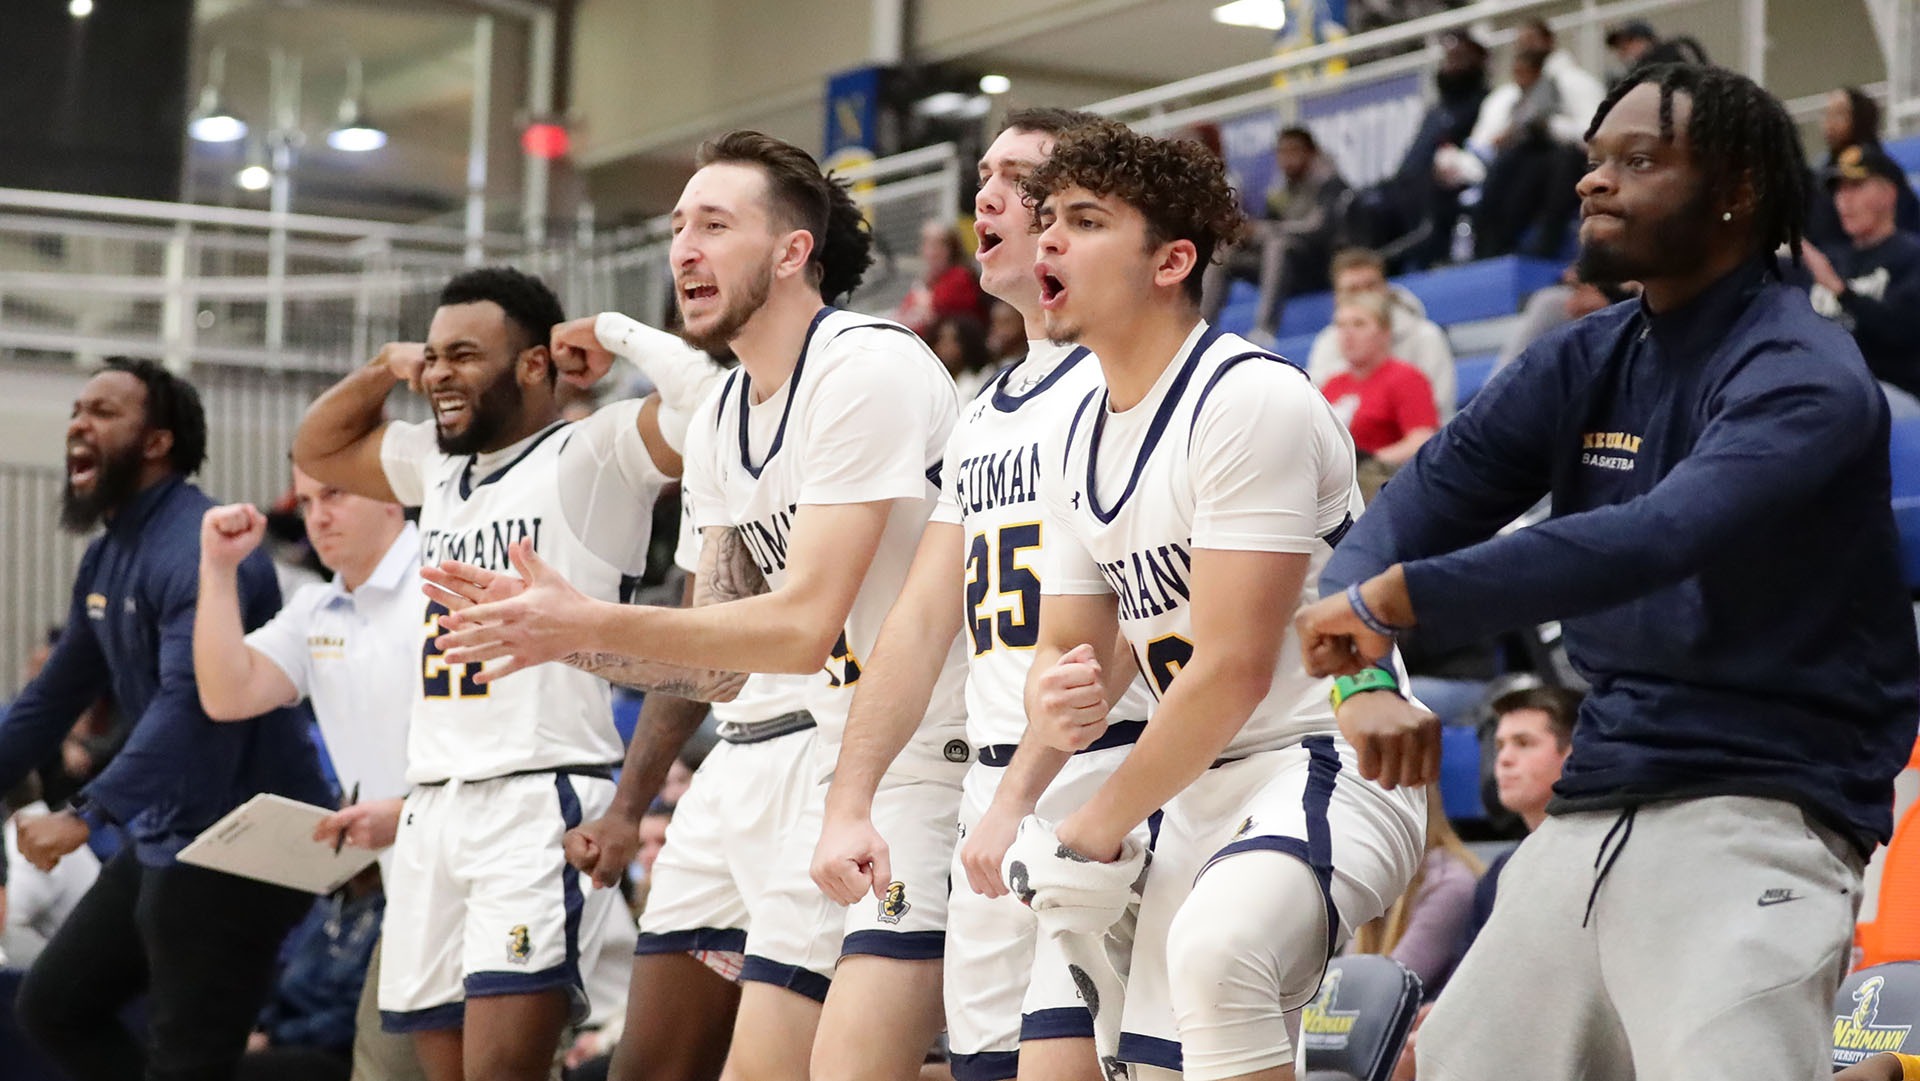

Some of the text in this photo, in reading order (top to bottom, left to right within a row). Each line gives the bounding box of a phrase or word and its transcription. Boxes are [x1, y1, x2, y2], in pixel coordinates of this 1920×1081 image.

[957, 443, 1040, 521] EUMAN
[966, 521, 1043, 658] 25
[1833, 1019, 1906, 1050] NEUMANN
